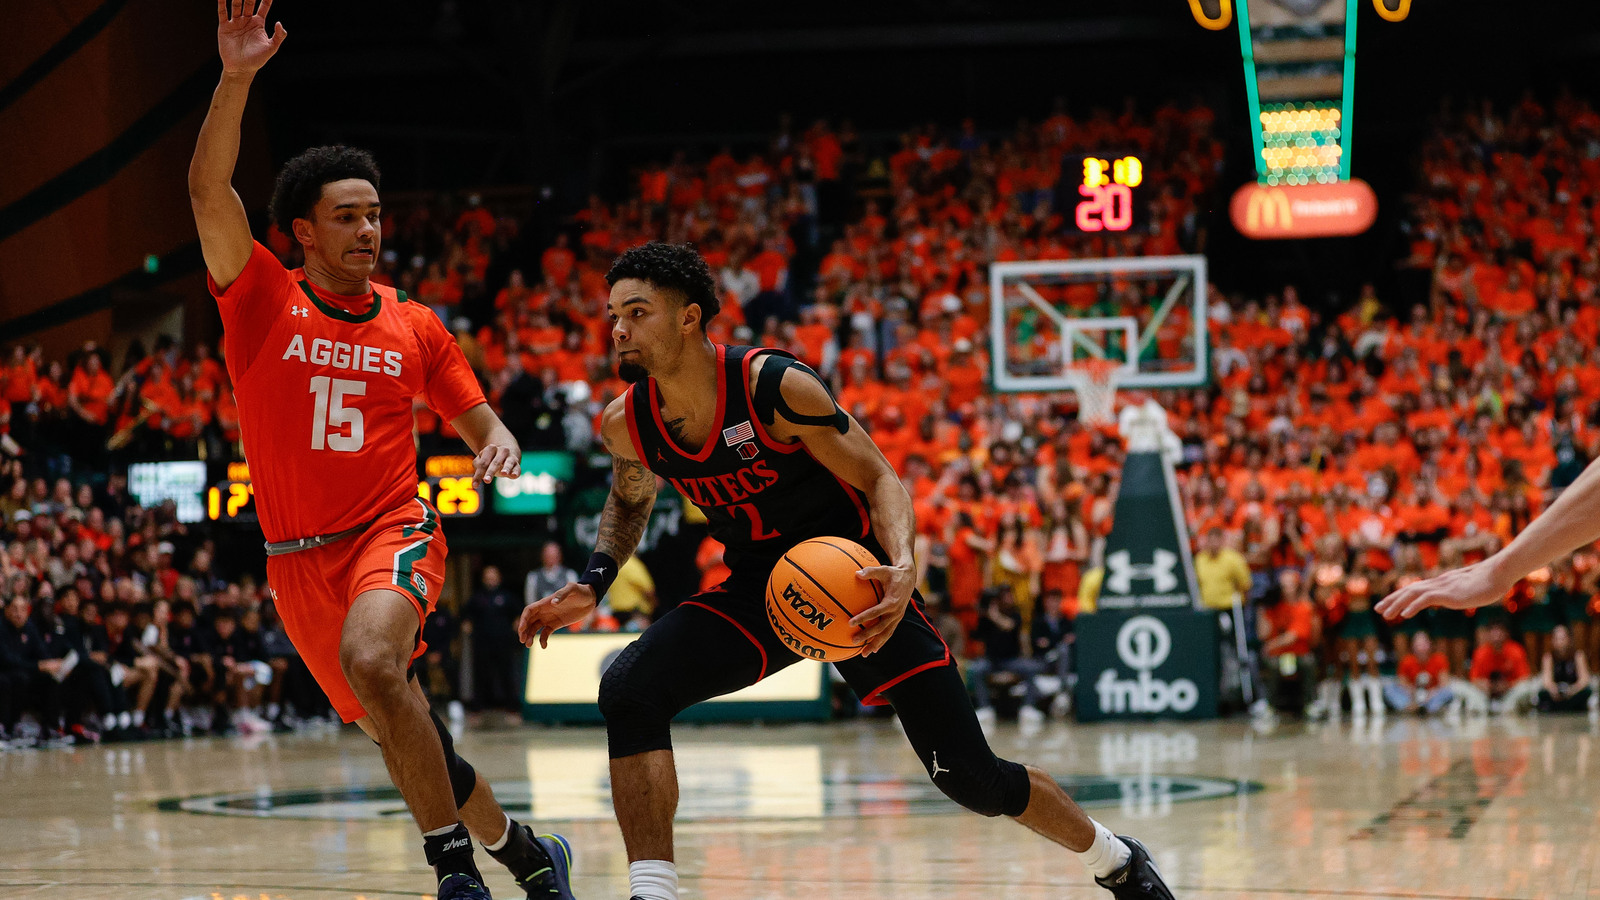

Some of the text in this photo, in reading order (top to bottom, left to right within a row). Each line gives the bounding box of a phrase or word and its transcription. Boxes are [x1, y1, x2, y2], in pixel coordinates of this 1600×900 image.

[1076, 183, 1132, 231] 20
[282, 334, 403, 377] AGGIES
[309, 375, 367, 452] 15
[726, 502, 782, 541] 2
[782, 582, 835, 632] NCAA
[1095, 667, 1200, 713] fnbo
